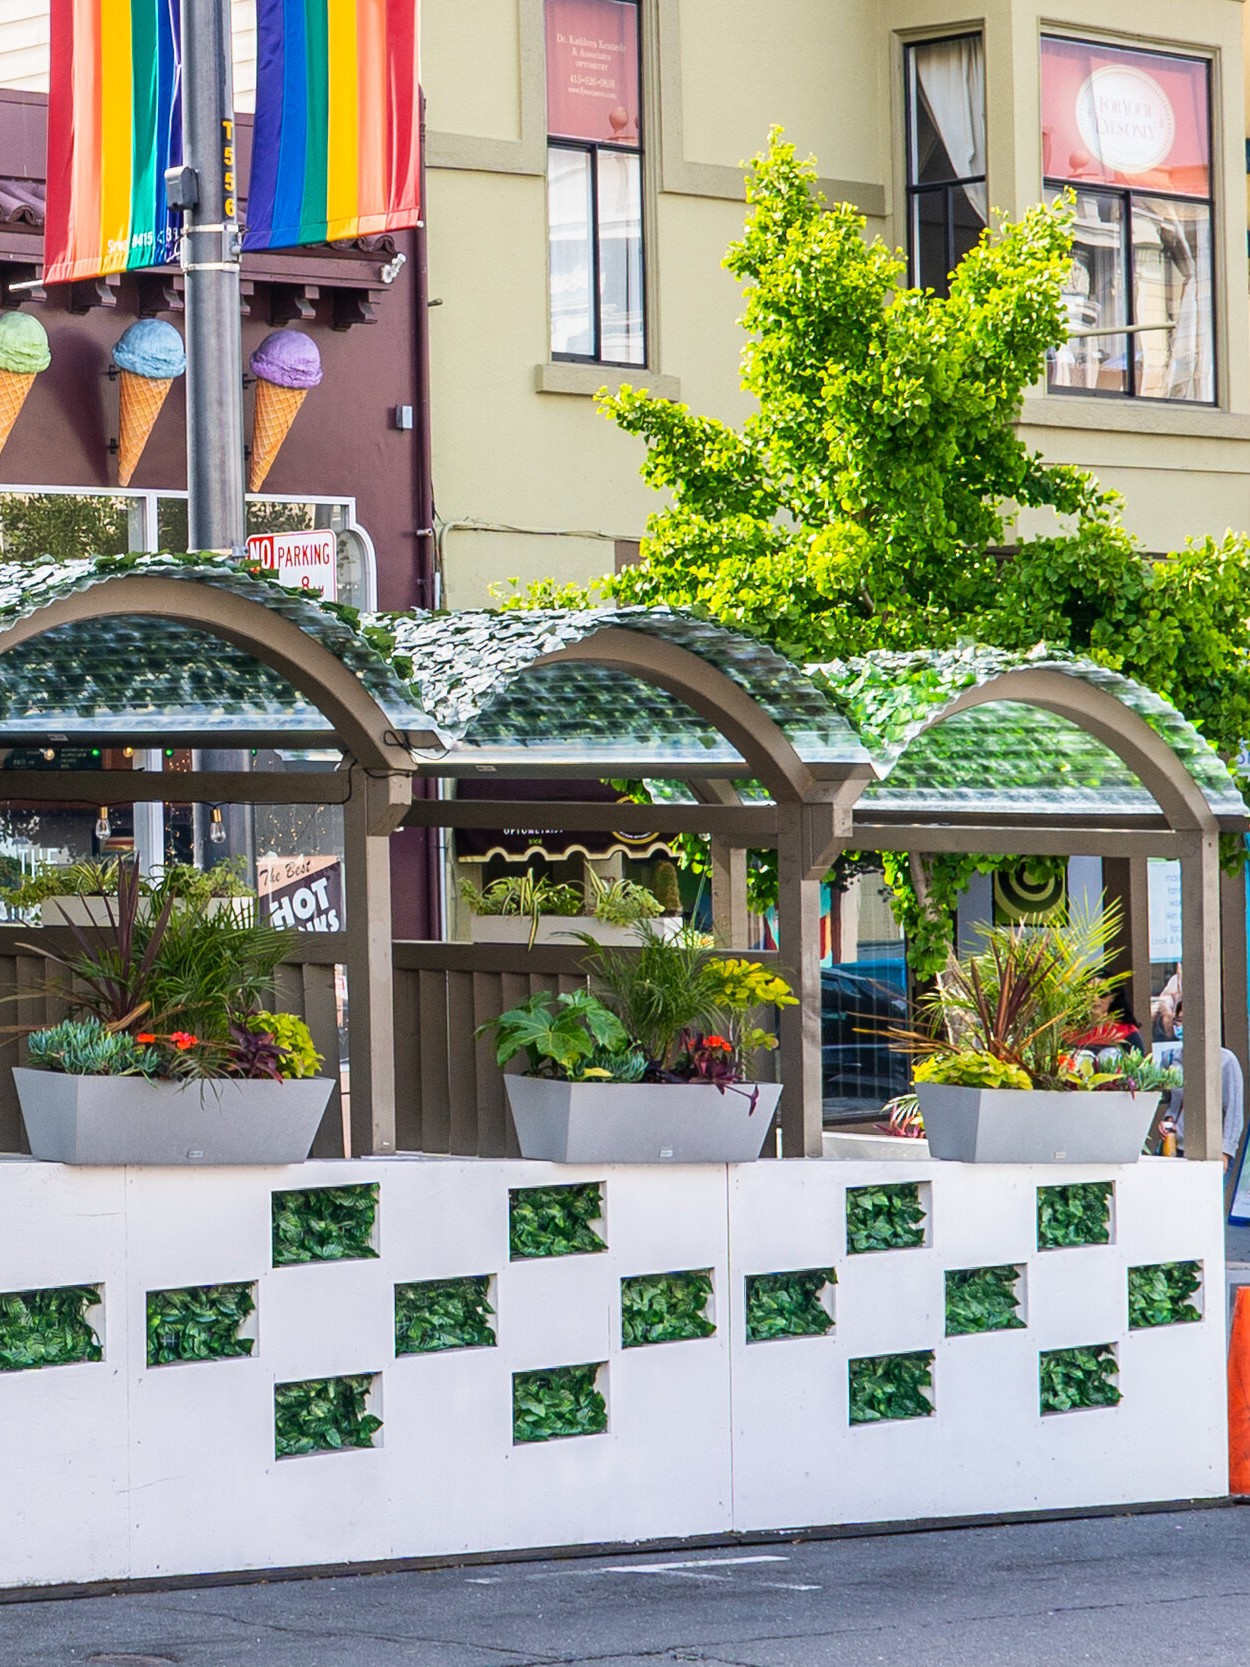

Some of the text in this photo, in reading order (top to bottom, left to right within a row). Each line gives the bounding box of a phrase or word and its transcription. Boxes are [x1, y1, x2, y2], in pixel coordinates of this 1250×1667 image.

[249, 540, 330, 569] NO PARKING
[259, 860, 311, 887] The Best
[269, 877, 330, 928] HOT
